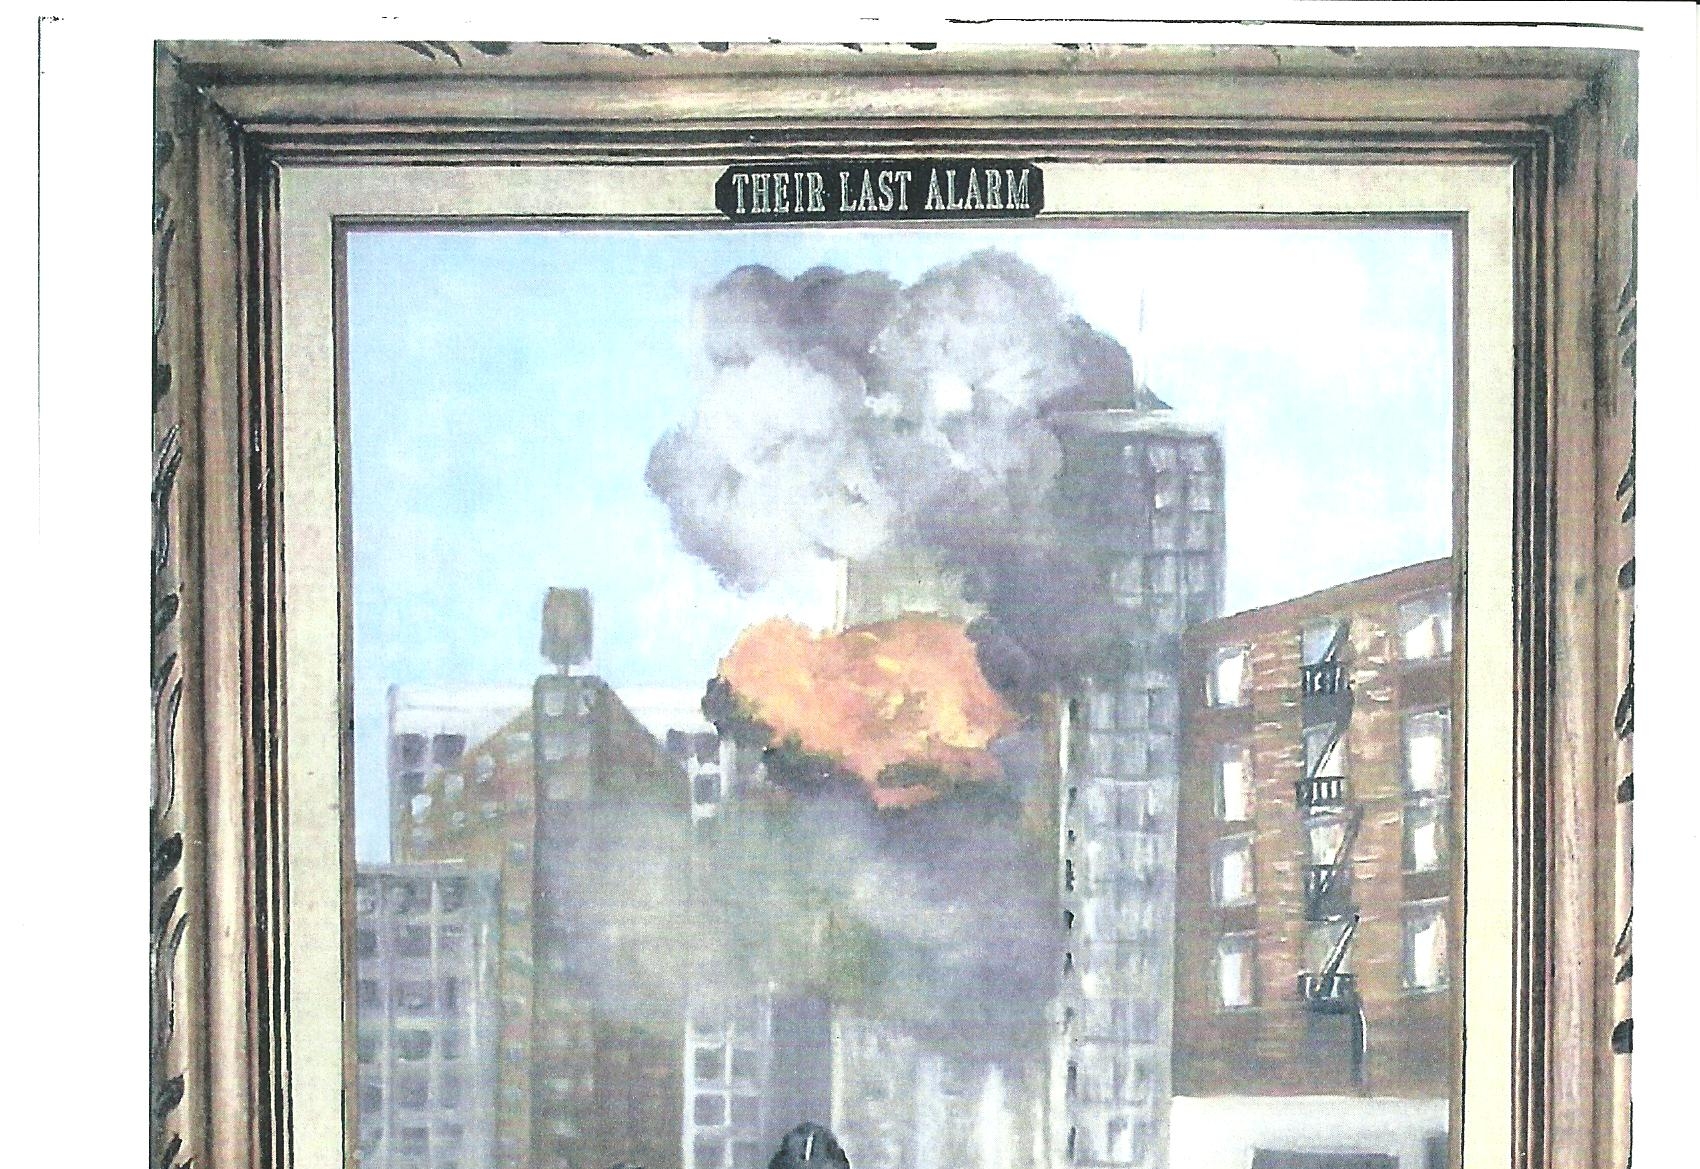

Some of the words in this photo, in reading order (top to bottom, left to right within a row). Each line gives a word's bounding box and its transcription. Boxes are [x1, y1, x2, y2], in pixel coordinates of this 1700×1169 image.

[732, 172, 825, 214] THEIR
[840, 169, 911, 211] LAST
[924, 167, 1030, 210] ALARM
